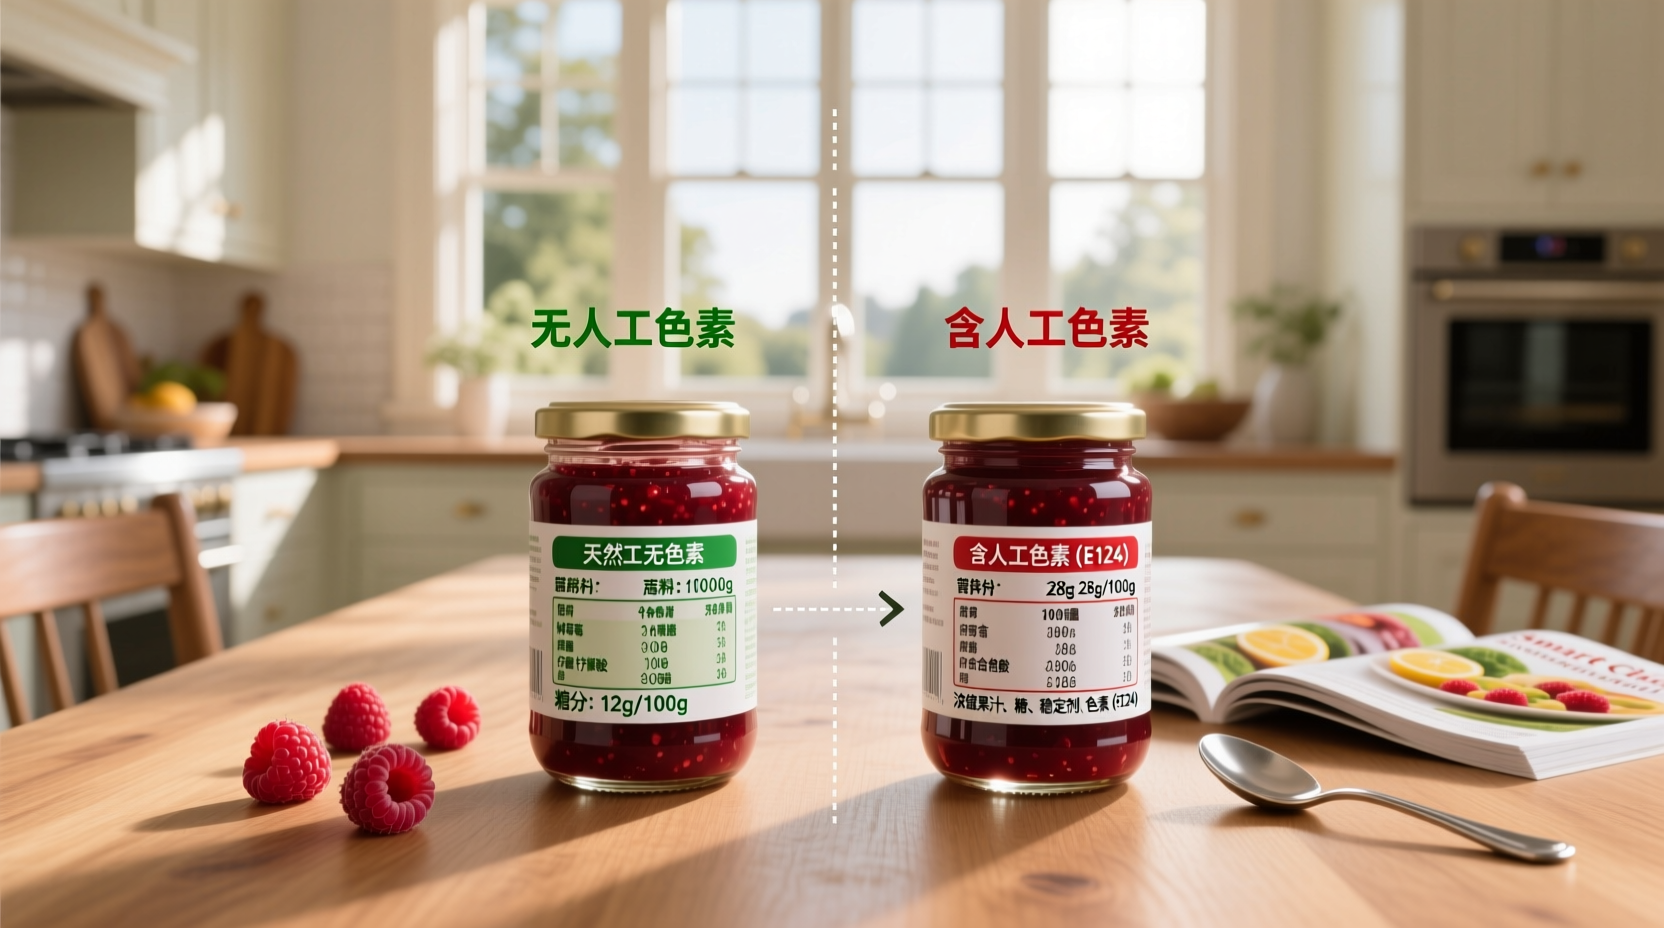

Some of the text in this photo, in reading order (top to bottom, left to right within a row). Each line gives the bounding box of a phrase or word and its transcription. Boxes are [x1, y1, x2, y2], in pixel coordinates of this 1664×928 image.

[583, 542, 705, 567] 天然工无色素
[970, 542, 1129, 568] 含人工色素 (E124)
[1046, 580, 1075, 599] 28g
[601, 694, 688, 717] 12g/100g
